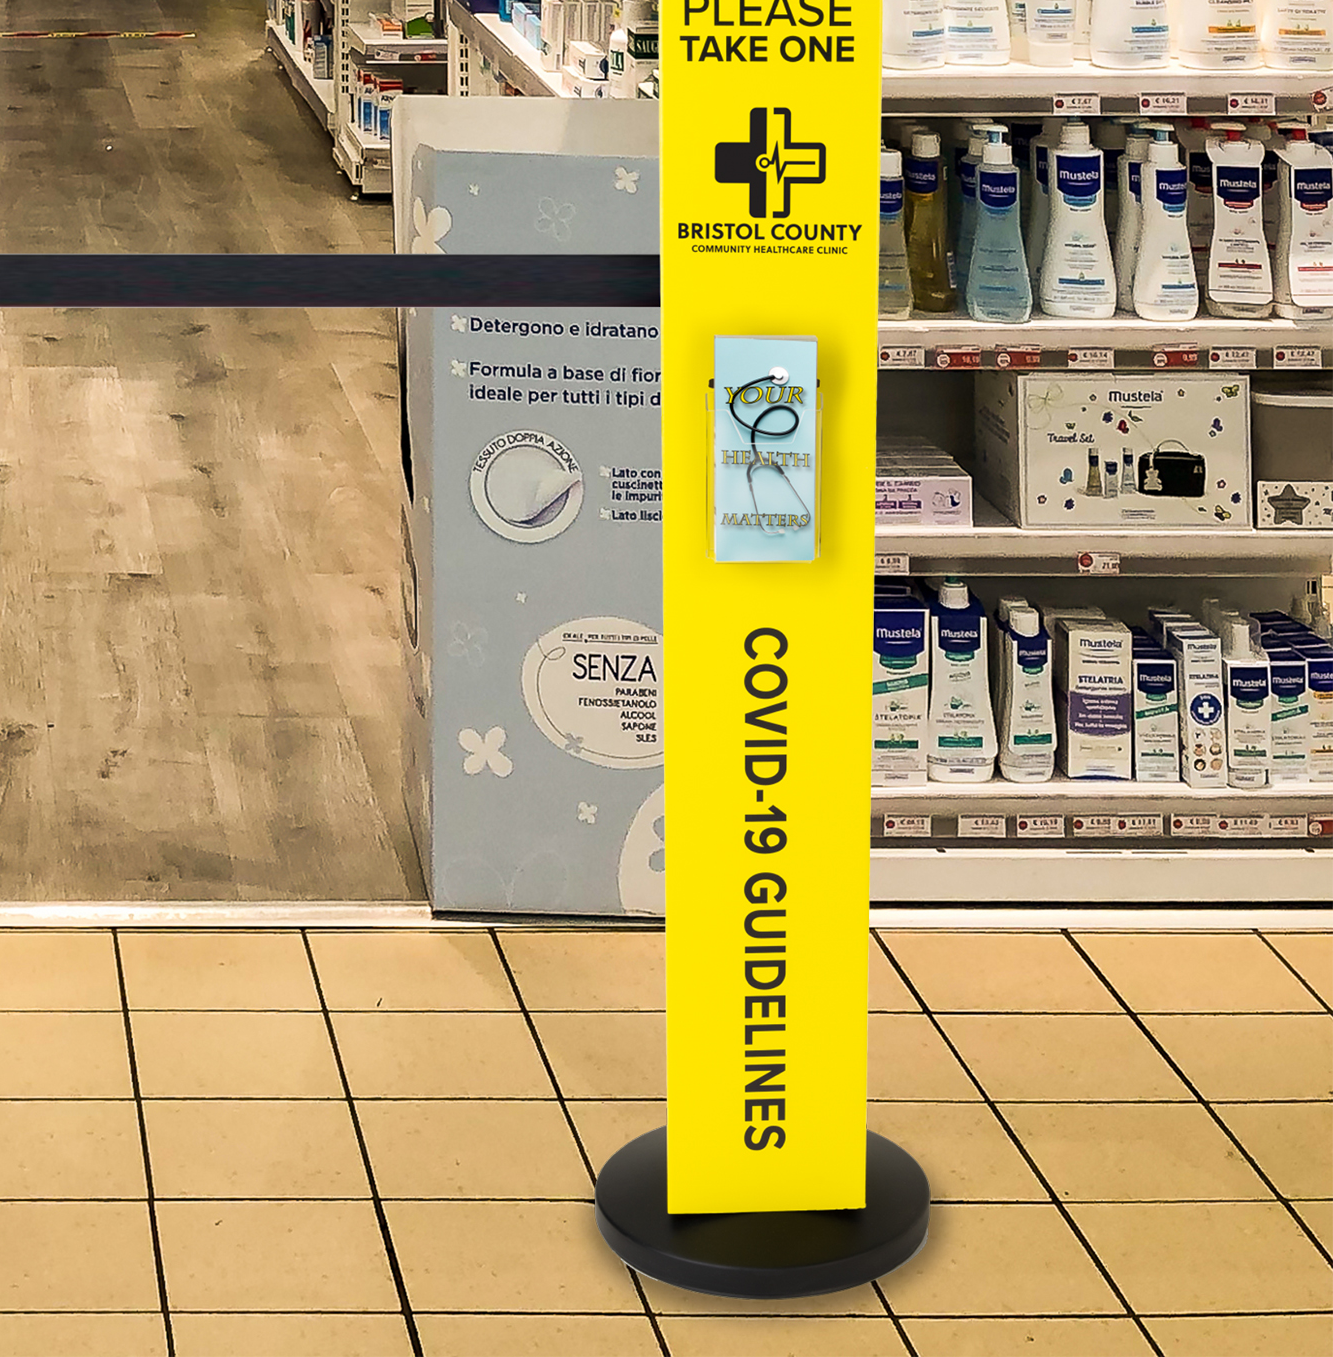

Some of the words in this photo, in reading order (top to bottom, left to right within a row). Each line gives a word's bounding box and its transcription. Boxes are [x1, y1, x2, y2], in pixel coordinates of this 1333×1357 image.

[679, 35, 768, 63] TAKE
[779, 35, 855, 63] ONE
[1059, 169, 1101, 182] Mustela
[981, 183, 1016, 195] Mustela
[1219, 178, 1258, 190] Mustela
[1296, 181, 1332, 192] Mustela
[677, 222, 766, 241] BRISTOL
[770, 222, 863, 242] COUNTY
[691, 245, 751, 254] COMMUNITY
[753, 245, 814, 255] HEALTHCARE
[816, 245, 848, 255] CLINIC
[469, 317, 564, 336] Detergono
[569, 323, 580, 336] e
[585, 321, 659, 338] idratano
[469, 361, 542, 379] Formula
[547, 367, 557, 380] a
[563, 365, 604, 381] base
[610, 366, 626, 382] di
[469, 385, 523, 402] ideale
[528, 389, 558, 405] per
[563, 389, 600, 405] tutti
[605, 389, 611, 404] i
[615, 391, 644, 408] tipi
[724, 386, 804, 406] YOUR
[1108, 390, 1163, 404] Mustela
[1047, 432, 1078, 445] Travel
[1080, 432, 1095, 444] Set
[472, 438, 507, 473] TESSUTO
[506, 433, 545, 446] DOPPIA
[547, 441, 579, 474] AZIONE
[720, 449, 810, 468] HEALTH
[611, 467, 638, 479] Lato
[640, 469, 661, 479] con
[612, 490, 622, 501] le
[611, 510, 637, 521] Lato
[719, 511, 809, 527] MATTERS
[876, 627, 923, 639] Mustela
[941, 629, 979, 639] Mustela
[1079, 638, 1123, 649] Mustela
[572, 653, 657, 683] SENZA
[1078, 675, 1124, 684] STELATRIA
[1139, 674, 1172, 683] Mustela
[1233, 678, 1267, 688] Mustela
[1272, 676, 1303, 685] Mustela
[615, 687, 657, 697] PARABENI
[578, 697, 657, 709] FENOSSIETANOLO
[620, 711, 657, 721] ALCOOL
[621, 722, 657, 732] SAPONE
[635, 733, 657, 743] SLES
[743, 627, 788, 854] COVID-19
[743, 871, 788, 1152] GUIDELINES
